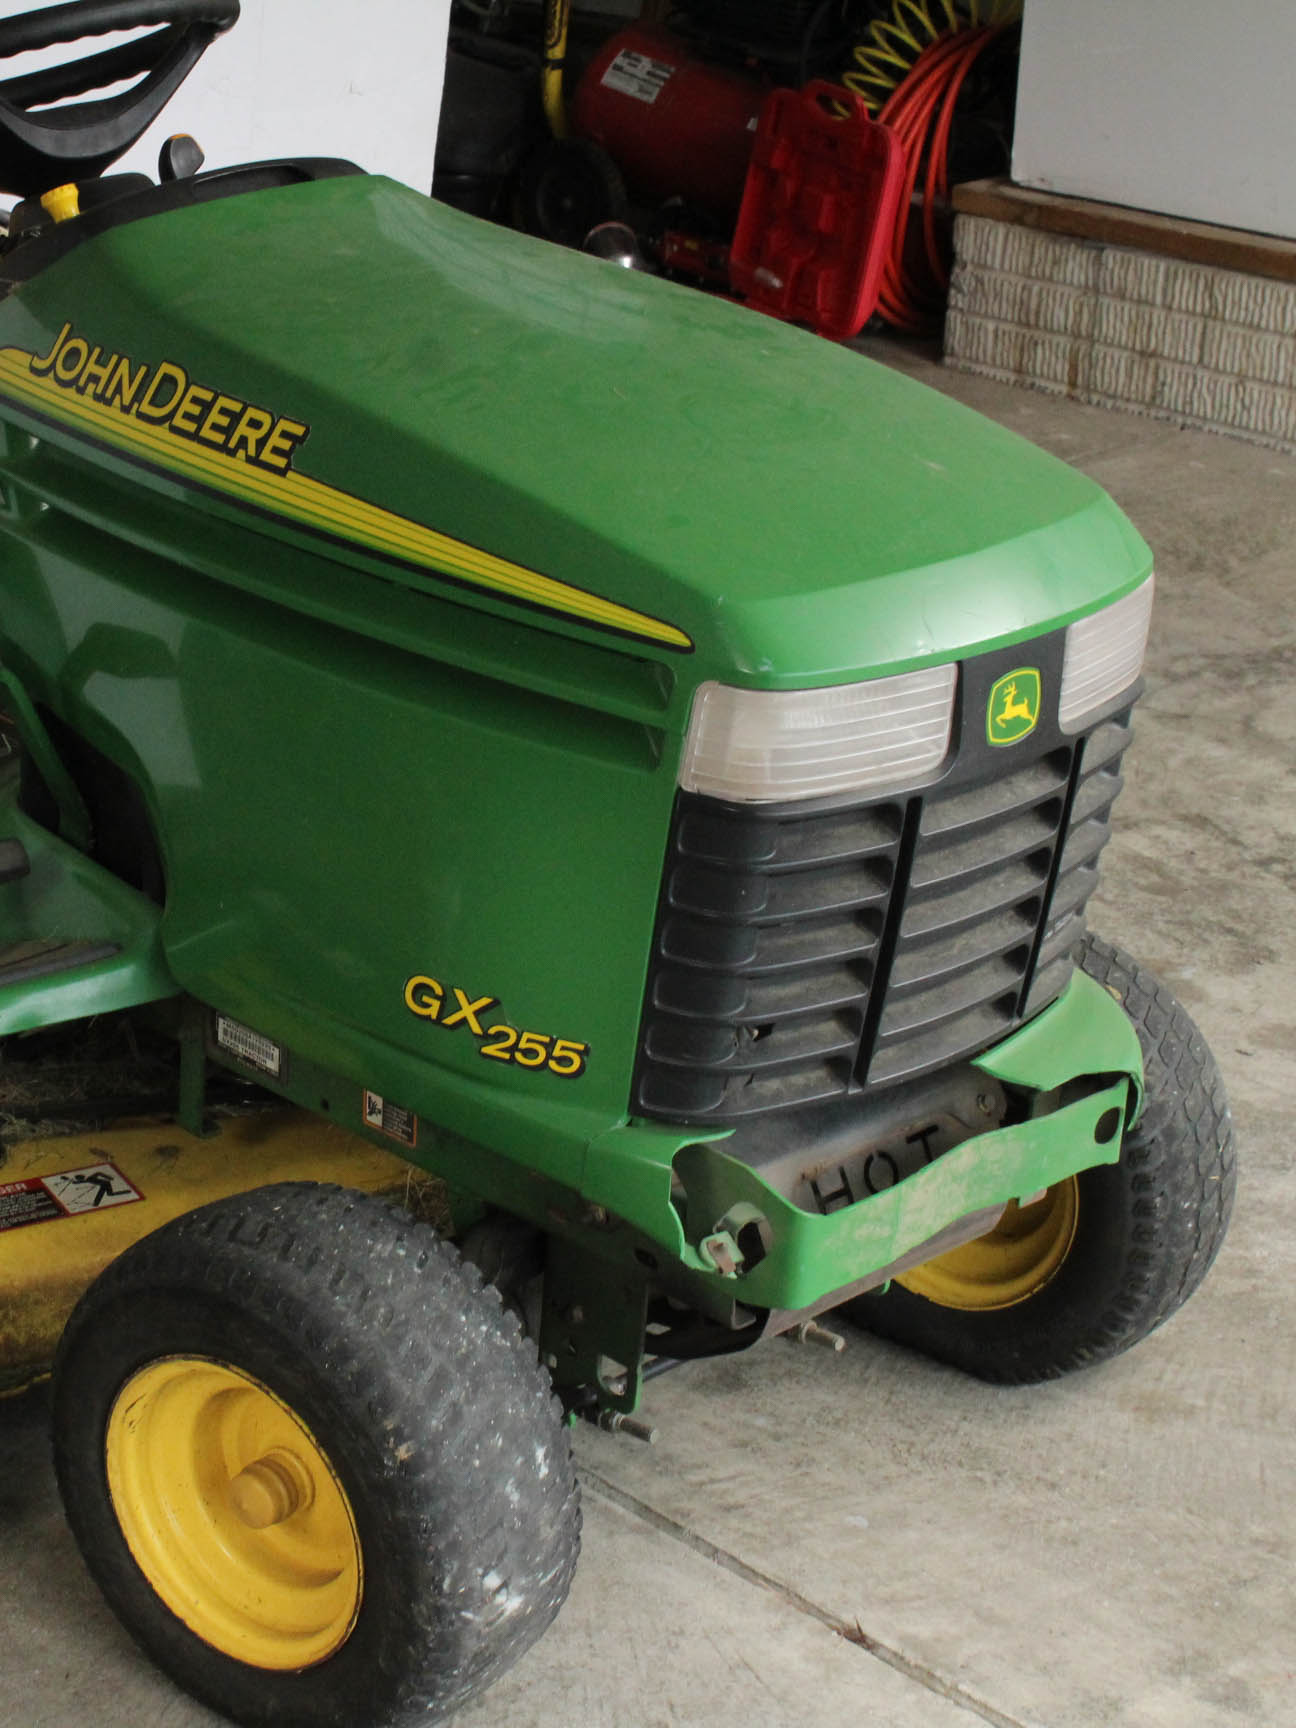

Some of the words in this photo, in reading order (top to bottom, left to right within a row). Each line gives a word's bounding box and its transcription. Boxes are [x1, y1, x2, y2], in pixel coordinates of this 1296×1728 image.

[30, 321, 148, 414] JOHN
[136, 360, 311, 477] DEERE
[810, 1124, 940, 1216] HOT
